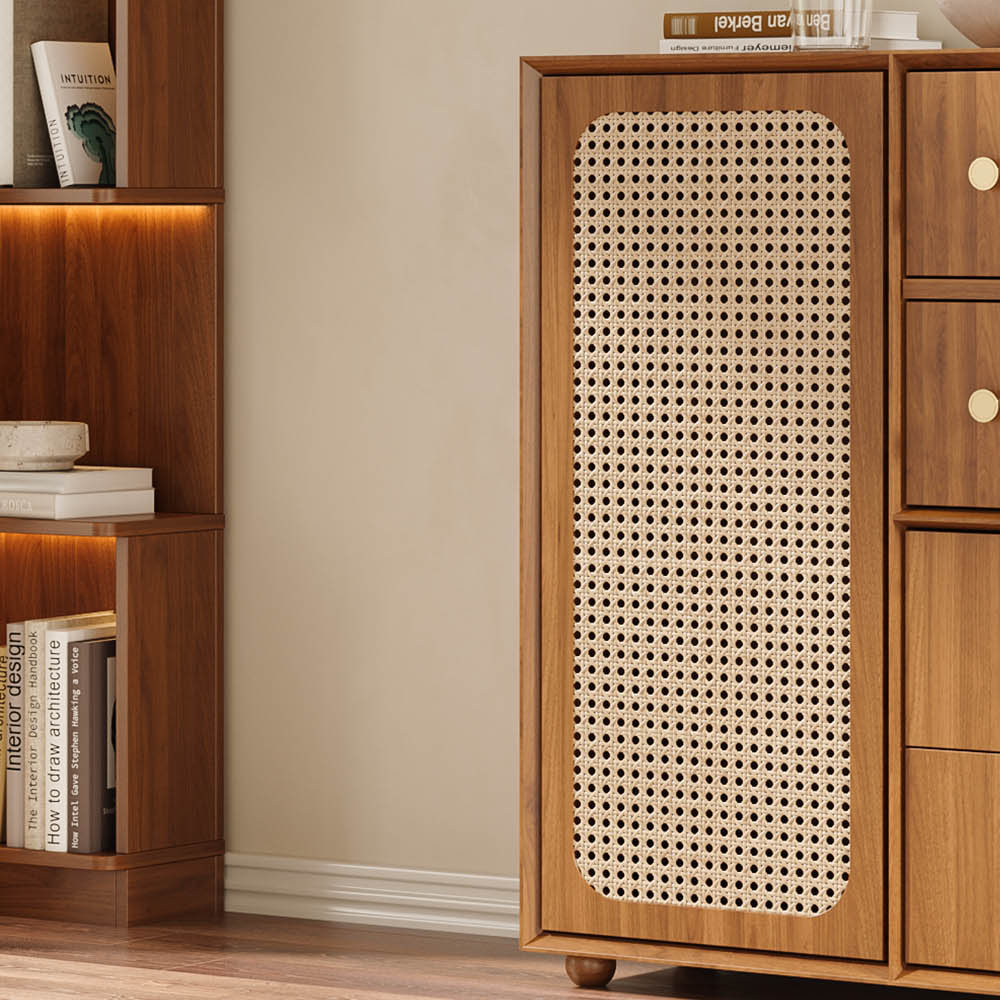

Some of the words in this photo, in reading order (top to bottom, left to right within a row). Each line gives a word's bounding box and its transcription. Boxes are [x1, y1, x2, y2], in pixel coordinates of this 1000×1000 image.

[713, 14, 763, 33] Berkel
[741, 44, 793, 54] iemeyer
[60, 72, 112, 85] INTUITION
[48, 118, 72, 187] INTUITION
[6, 631, 25, 697] design
[28, 631, 38, 688] Handbook
[71, 646, 80, 674] Voice
[47, 639, 61, 737] architecture
[28, 694, 41, 738] Design
[70, 688, 81, 728] Hawking
[6, 702, 22, 771] Interior
[70, 731, 81, 769] Stephen
[28, 746, 38, 802] Interior
[47, 743, 61, 783] draw
[47, 788, 61, 803] to
[71, 774, 79, 796] Gave
[28, 808, 38, 830] The
[47, 809, 61, 845] How
[70, 800, 79, 827] Intel
[71, 831, 79, 849] How
